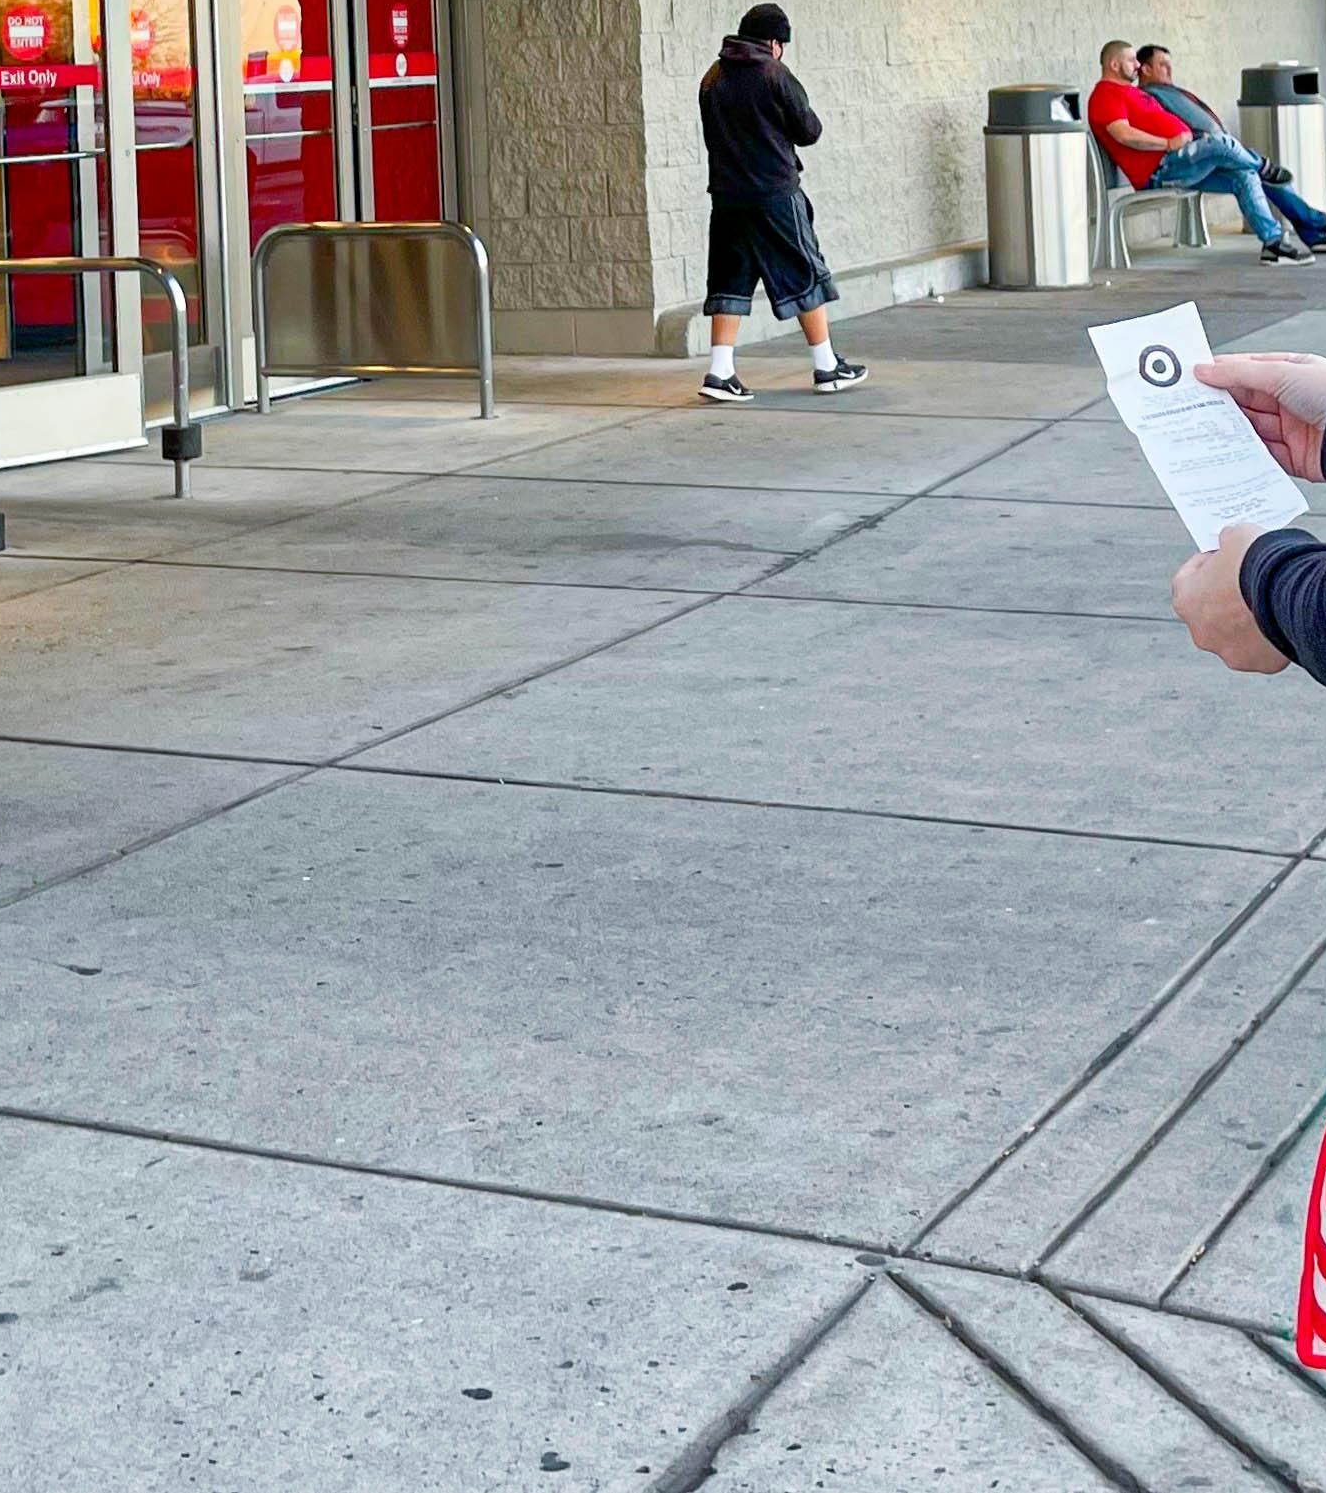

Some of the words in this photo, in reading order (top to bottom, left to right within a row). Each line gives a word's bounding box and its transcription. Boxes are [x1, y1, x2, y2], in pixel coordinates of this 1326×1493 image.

[7, 16, 22, 26] DO
[24, 16, 43, 25] NOT
[10, 37, 43, 48] ENTER
[0, 70, 25, 86] Exit
[28, 69, 58, 87] Only
[141, 71, 160, 88] Only
